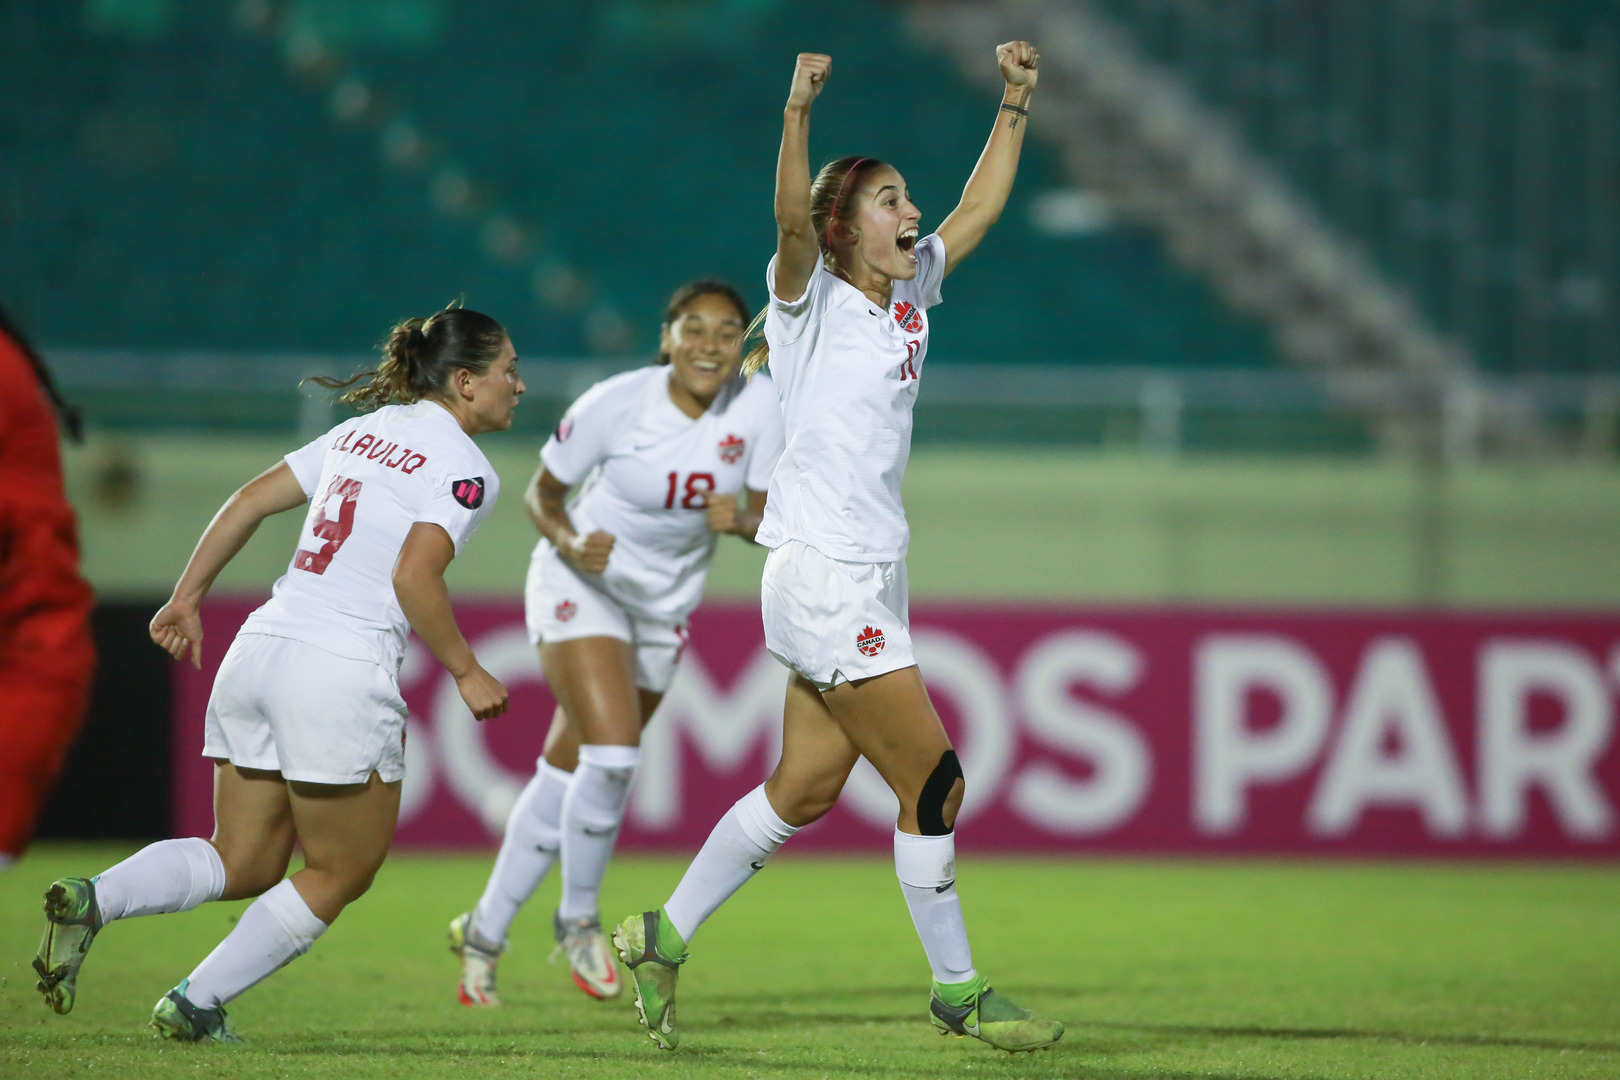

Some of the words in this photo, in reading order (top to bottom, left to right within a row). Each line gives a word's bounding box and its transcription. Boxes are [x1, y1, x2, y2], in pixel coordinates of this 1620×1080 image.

[899, 306, 917, 329] CANADA
[664, 471, 716, 509] 18
[293, 473, 363, 576] 9
[856, 635, 886, 648] CANADA
[1193, 630, 1620, 840] PAR
